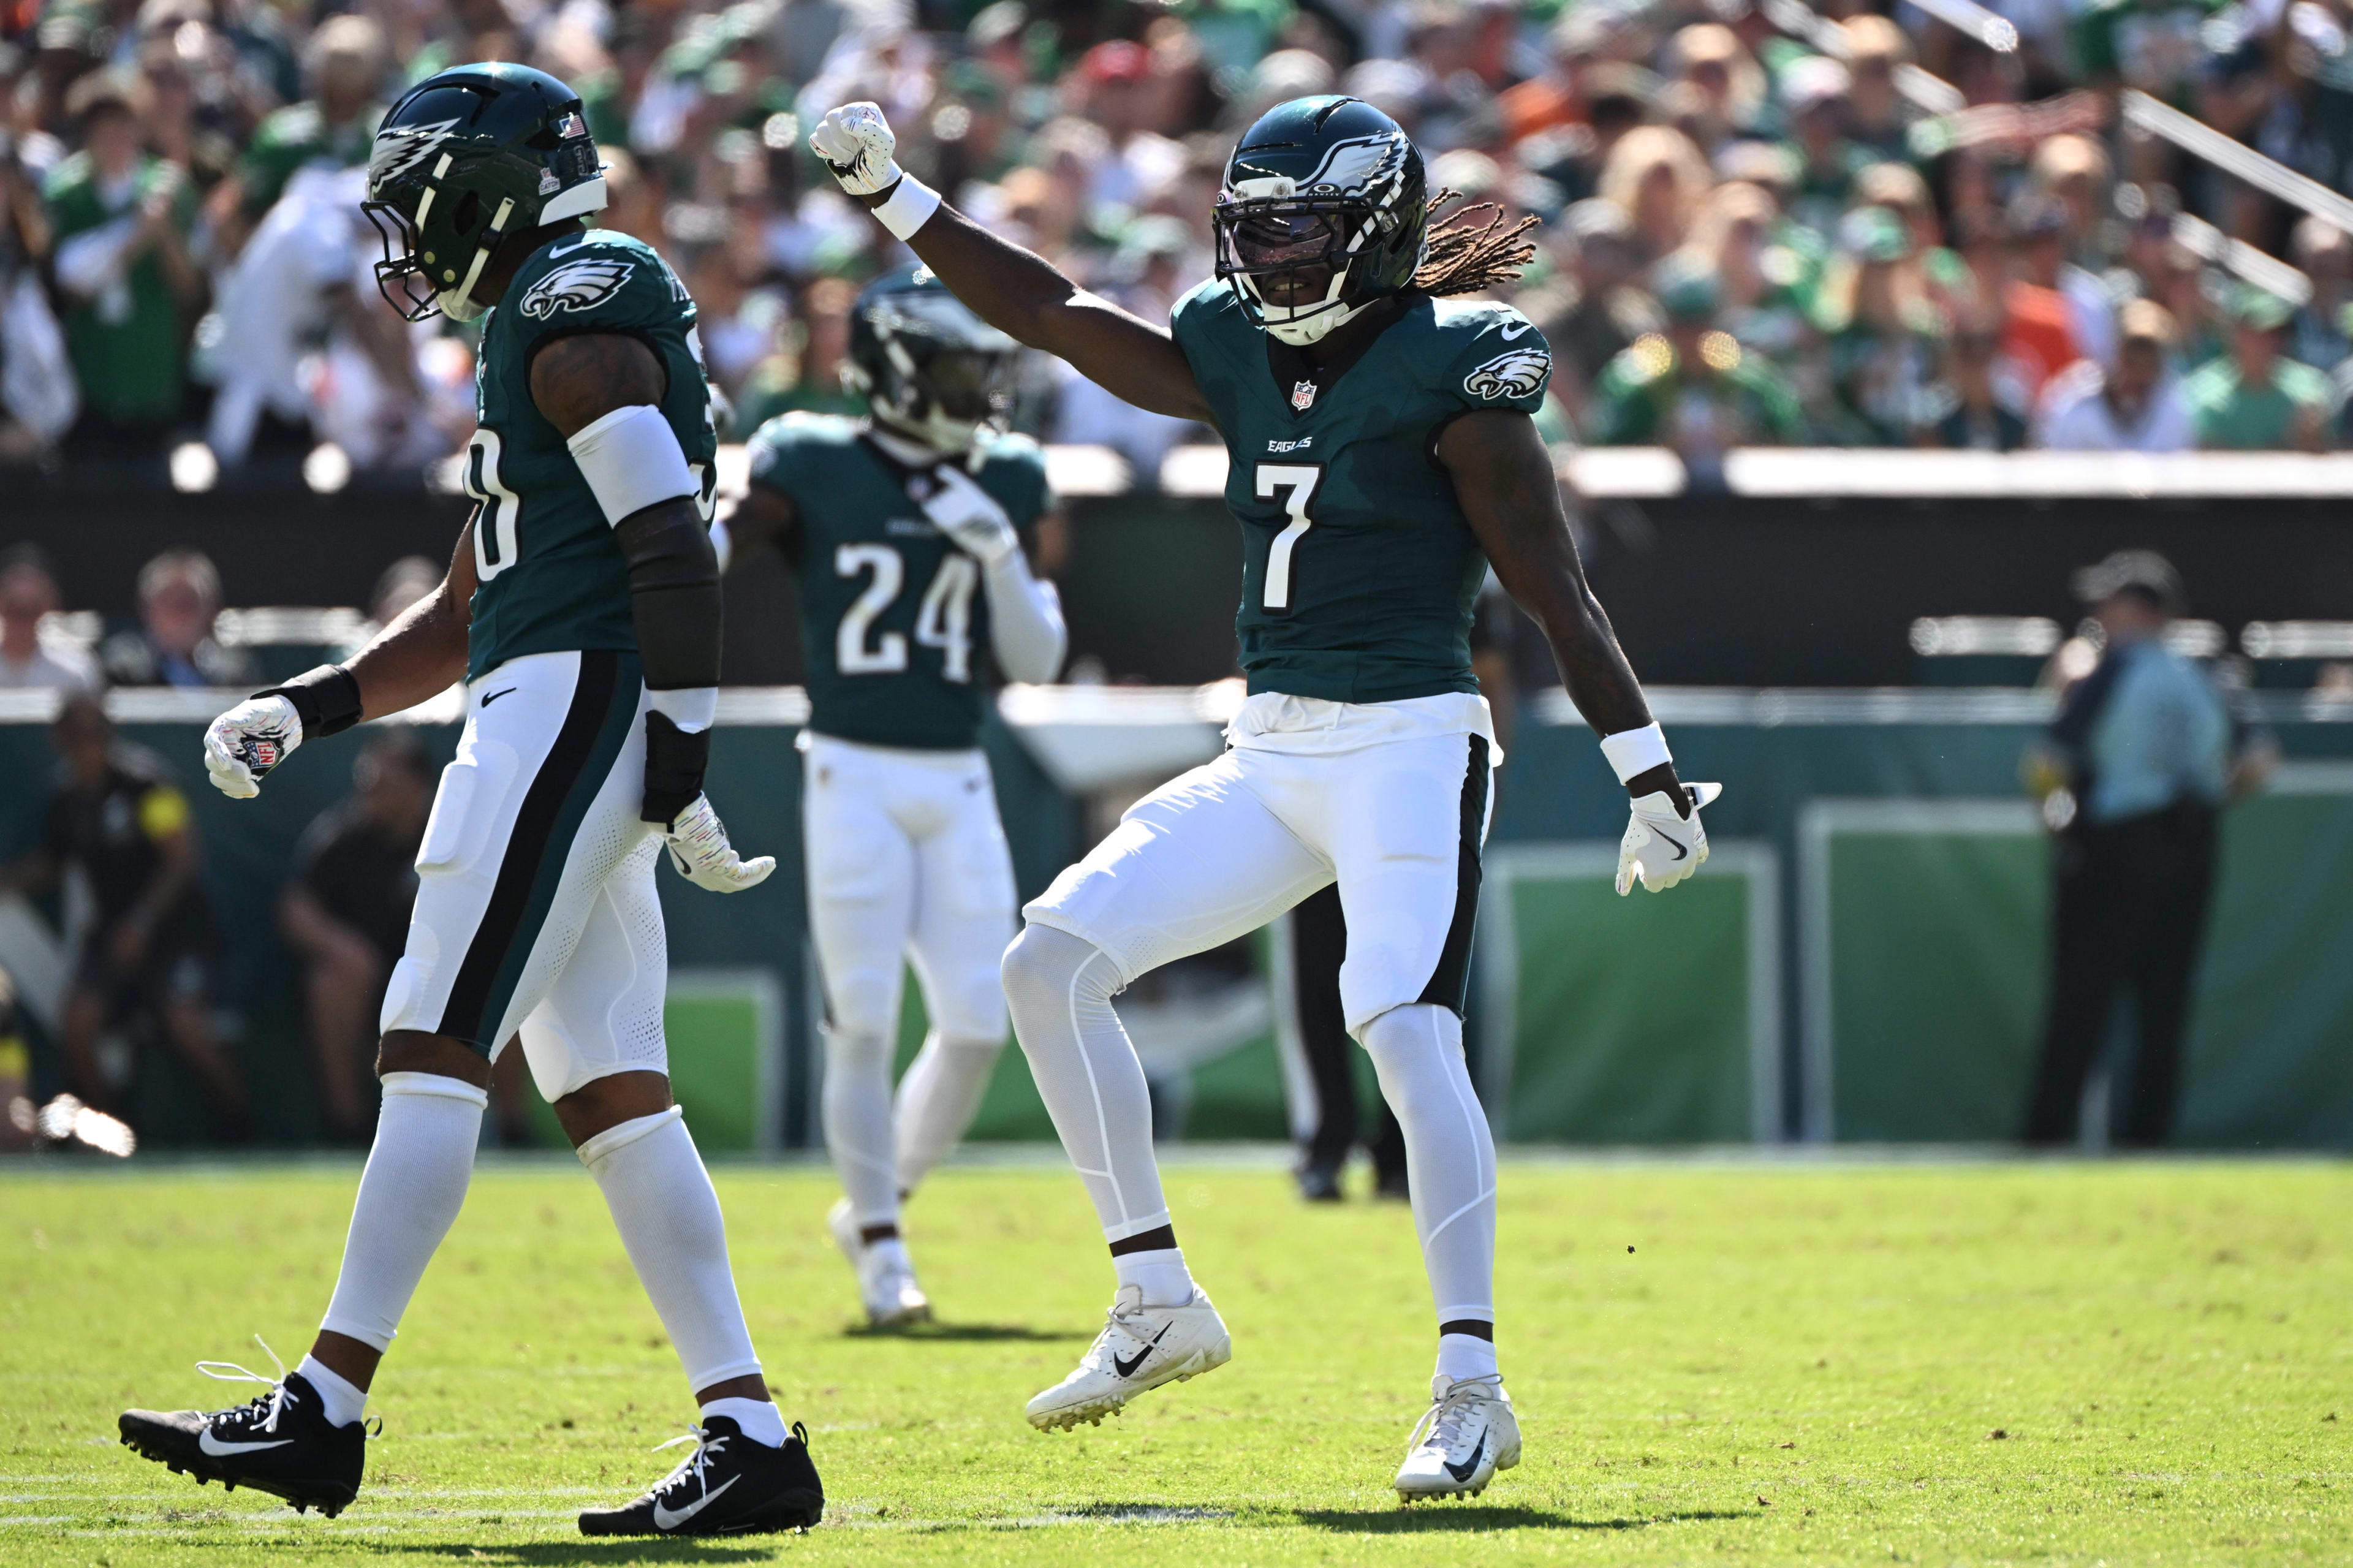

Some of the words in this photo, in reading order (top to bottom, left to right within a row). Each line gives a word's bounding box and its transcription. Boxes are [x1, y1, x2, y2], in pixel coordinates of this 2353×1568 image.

[1294, 392, 1309, 404] NFL
[1267, 437, 1313, 452] EAGLES
[1256, 464, 1320, 608] 7
[835, 543, 977, 684] 24
[257, 743, 275, 763] NFL
